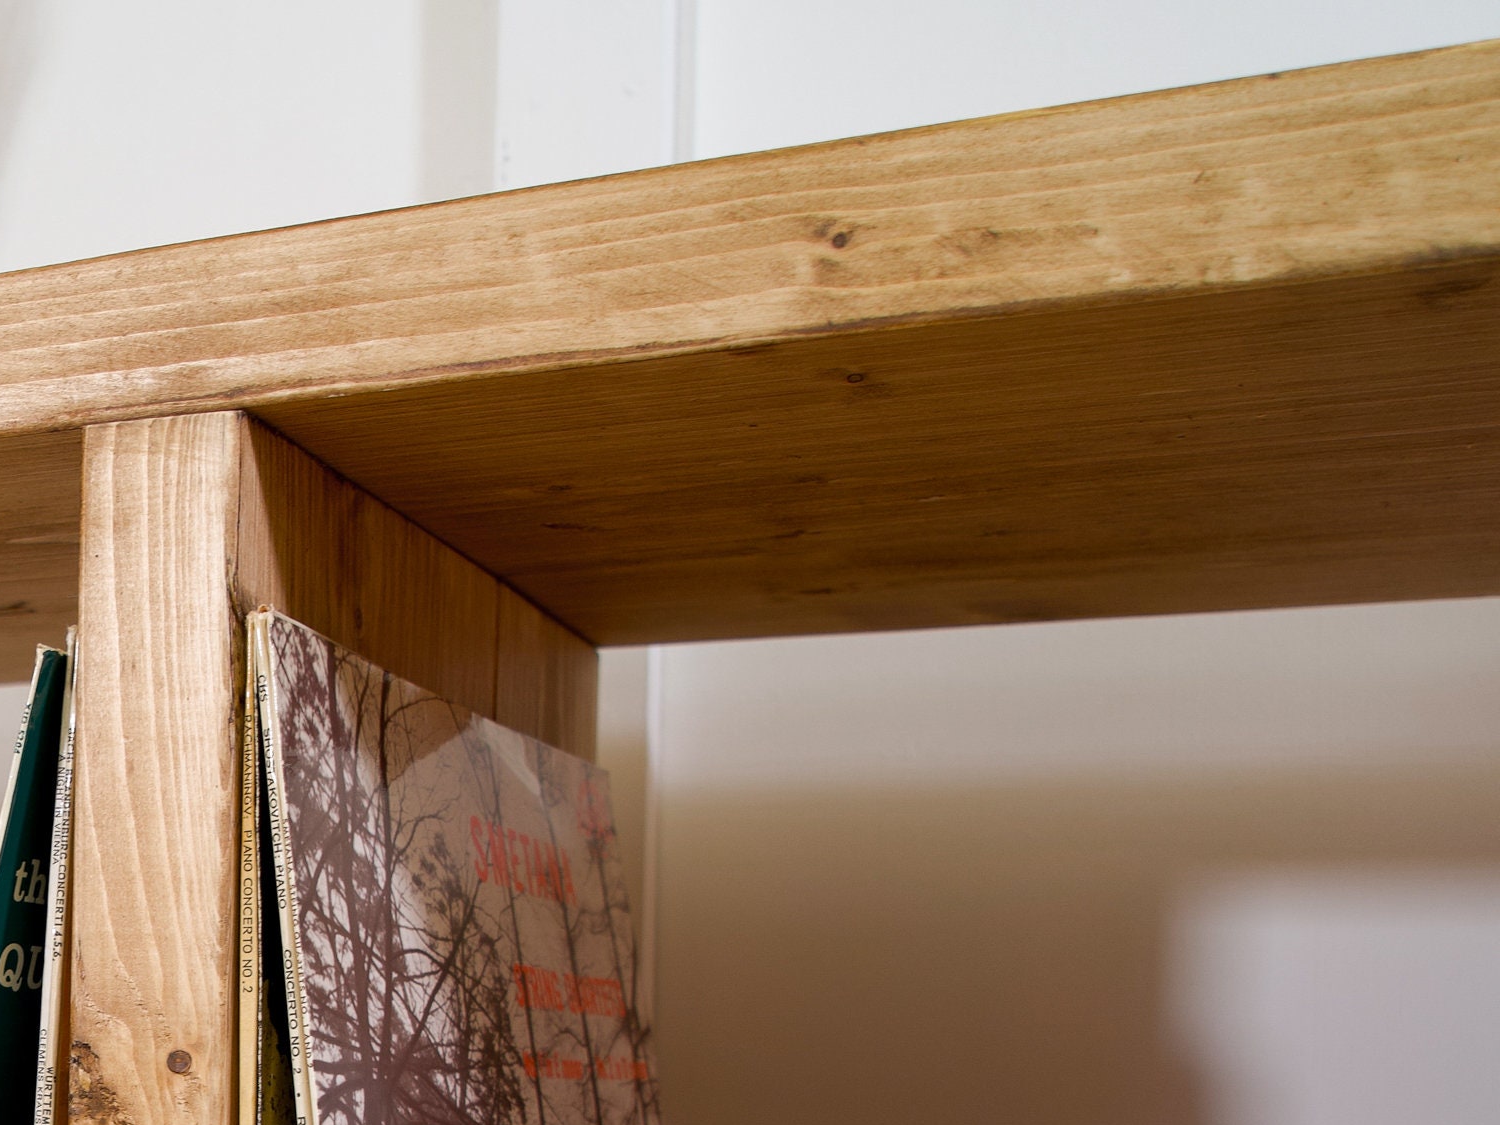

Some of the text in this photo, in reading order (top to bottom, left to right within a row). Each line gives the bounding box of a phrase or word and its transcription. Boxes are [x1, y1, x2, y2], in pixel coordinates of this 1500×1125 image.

[55, 767, 66, 804] NIGHT
[54, 807, 63, 819] IN
[59, 769, 73, 861] BRANDENBURG
[52, 824, 61, 865] VIENNA
[242, 829, 253, 872] PIANO
[471, 815, 577, 908] SMETANA
[54, 864, 68, 927] CONCERTI
[276, 865, 288, 910] PIANO
[242, 878, 253, 954] CONCERTO
[284, 949, 298, 1030] CONCERTO
[293, 1067, 302, 1075] 2
[37, 1029, 48, 1081] CLEMENS
